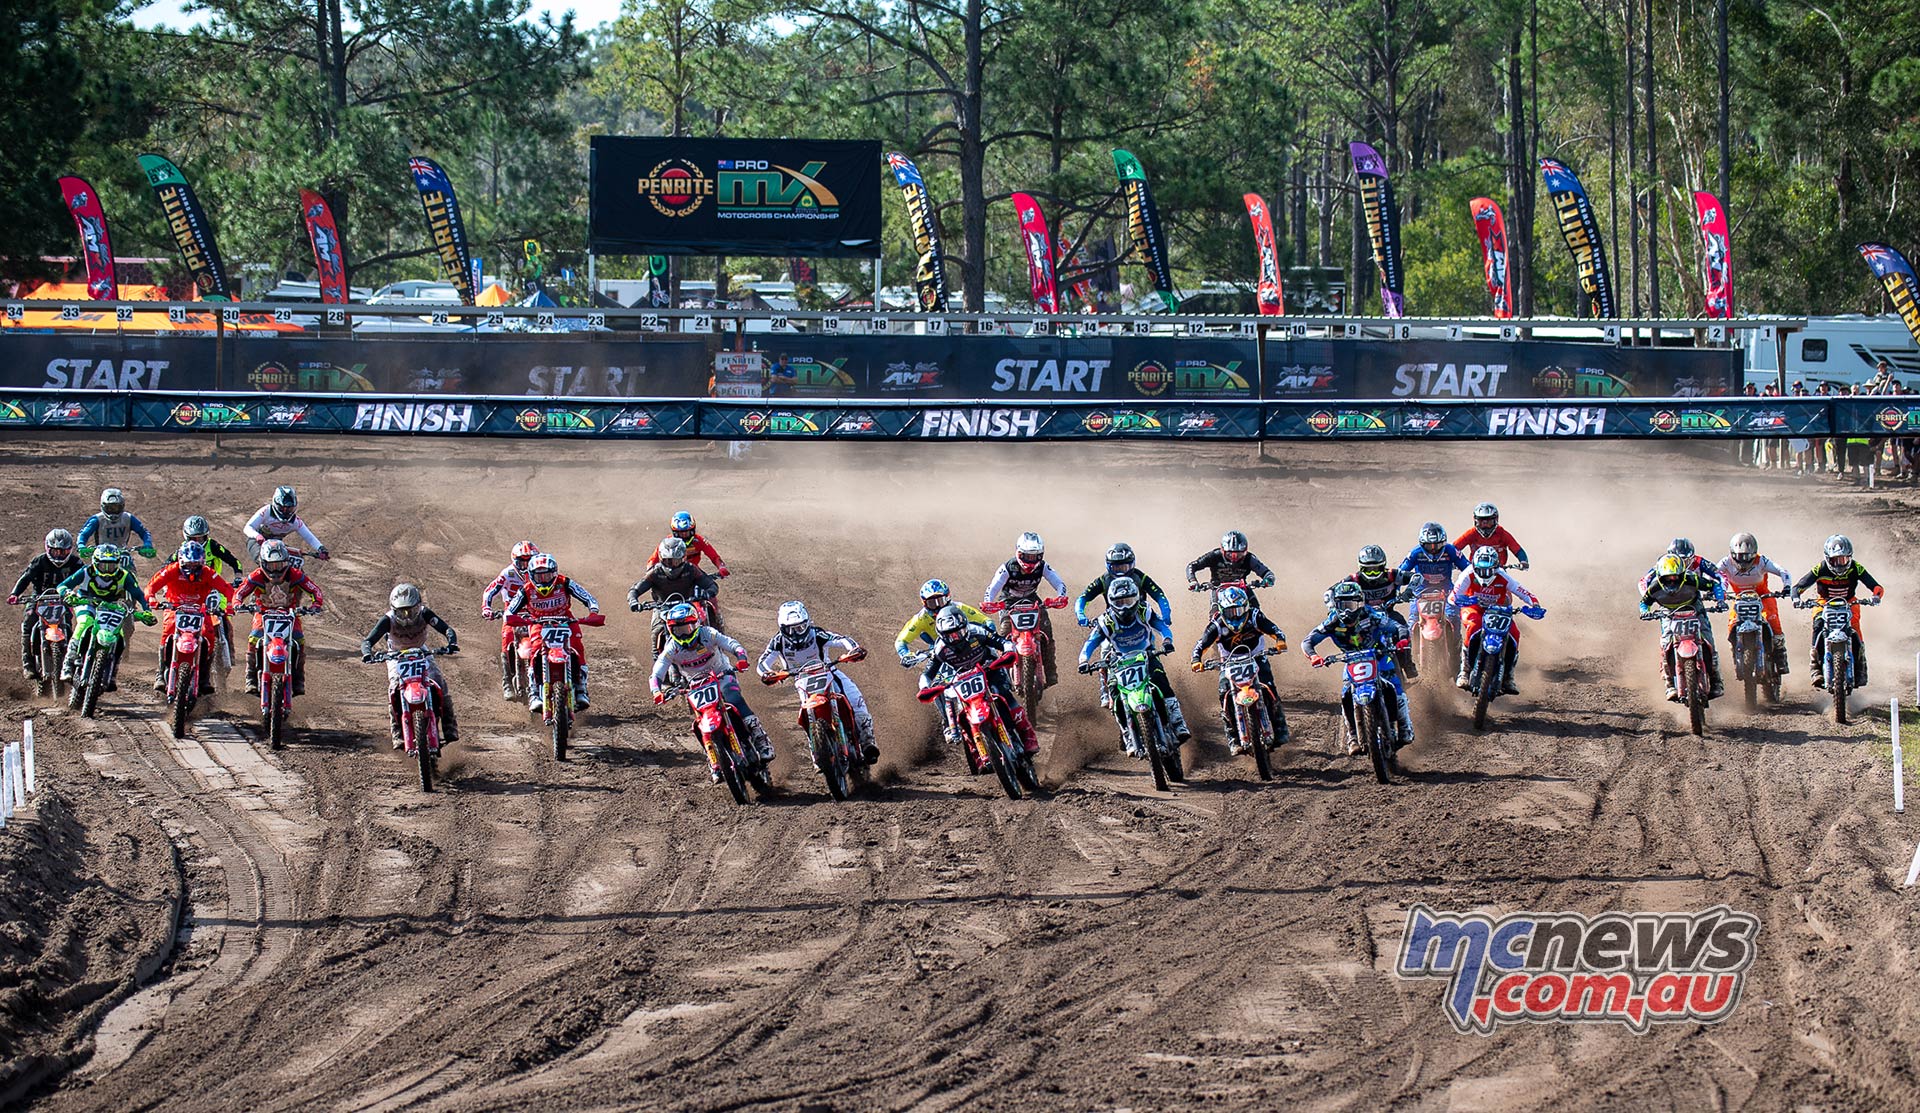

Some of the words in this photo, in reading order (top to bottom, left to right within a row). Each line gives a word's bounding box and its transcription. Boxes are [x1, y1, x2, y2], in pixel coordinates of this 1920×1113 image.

[735, 160, 768, 170] PRO
[638, 178, 714, 195] PENRITE
[1124, 181, 1152, 263] PENRITE
[1360, 177, 1384, 262] PENRITE
[160, 186, 206, 271] PENRITE
[424, 190, 468, 290] PENRITE
[1554, 190, 1597, 294] PENRITE
[8, 307, 22, 316] 34
[64, 307, 79, 317] 33
[118, 308, 132, 319] 32
[170, 309, 184, 320] 31
[224, 310, 239, 320] 30
[276, 311, 291, 321] 29
[329, 312, 344, 322] 28
[433, 314, 448, 324] 26
[488, 314, 503, 324] 25
[538, 316, 552, 325] 24
[588, 316, 604, 326] 23
[642, 316, 656, 326] 22
[696, 316, 709, 326] 21
[772, 318, 786, 328] 20
[824, 319, 838, 329] 19
[874, 320, 886, 330] 18
[930, 321, 941, 331] 17
[980, 322, 992, 332] 16
[1035, 322, 1048, 332] 15
[1084, 322, 1096, 332] 14
[1136, 323, 1148, 332] 13
[1190, 324, 1203, 334] 12
[1243, 324, 1254, 334] 11
[1292, 325, 1304, 335] 10
[1349, 326, 1356, 334] 9
[1402, 326, 1409, 338] 8
[1451, 328, 1457, 336] 7
[1504, 328, 1511, 338] 6
[1607, 328, 1614, 338] 4
[1713, 328, 1720, 338] 2
[1764, 328, 1770, 338] 1
[42, 358, 170, 390] START
[248, 374, 296, 384] PENRITE
[992, 358, 1110, 392] START
[1128, 372, 1173, 382] PENRITE
[526, 366, 646, 396] START
[1392, 364, 1508, 397] START
[1532, 378, 1573, 389] PENRITE
[354, 404, 472, 431] FINISH
[740, 418, 770, 426] PENRITE
[921, 410, 1038, 436] FINISH
[1082, 418, 1112, 426] PENRITE
[1488, 408, 1606, 435] FINISH
[106, 527, 126, 538] FLY
[289, 557, 303, 568] 93
[550, 597, 565, 607] LEE
[44, 606, 64, 619] 41
[1422, 601, 1442, 615] 48
[98, 613, 122, 626] 32
[178, 616, 202, 628] 84
[1018, 612, 1036, 626] 8
[1486, 615, 1510, 630] 30
[1827, 613, 1848, 624] 23
[268, 620, 290, 634] 17
[1674, 620, 1698, 636] 415
[544, 630, 570, 644] 45
[400, 662, 426, 678] 215
[1230, 665, 1255, 682] 24
[1354, 662, 1372, 680] 9
[1120, 666, 1144, 686] 121
[806, 674, 828, 692] 5
[961, 678, 984, 698] 96
[694, 685, 717, 708] 20
